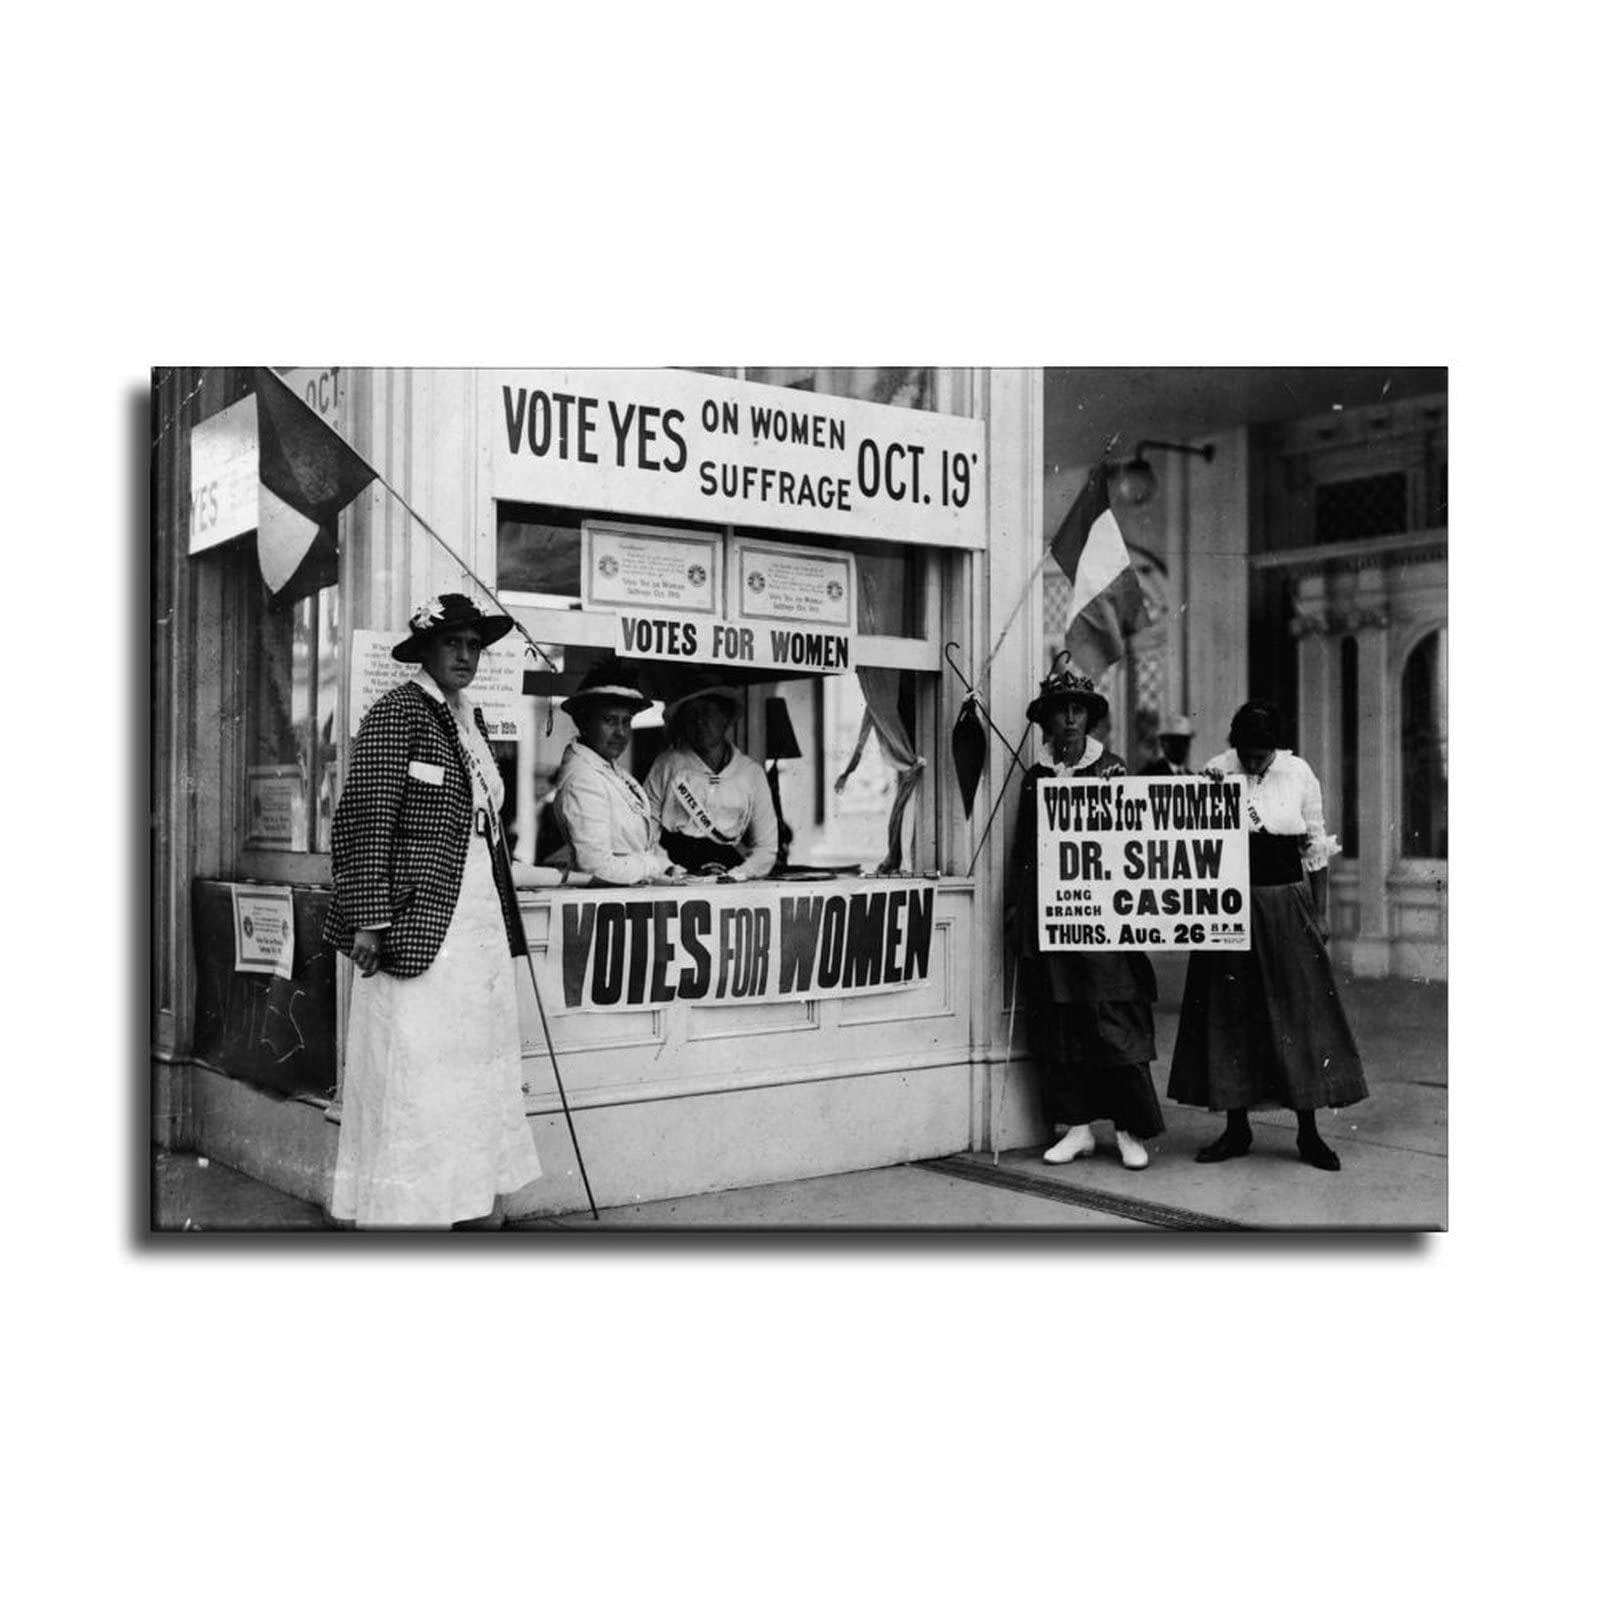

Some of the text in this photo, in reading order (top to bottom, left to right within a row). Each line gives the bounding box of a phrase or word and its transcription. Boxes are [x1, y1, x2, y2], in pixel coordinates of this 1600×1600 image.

[502, 385, 688, 473] VOTE YES
[702, 399, 846, 450] ON WOMEN
[699, 460, 852, 511] SUFFRAGE
[857, 438, 931, 505] OCT.
[621, 617, 849, 668] VOTES FOR WOMEN
[1043, 783, 1241, 832] VOTES for WOMEN
[1059, 839, 1223, 881] DR. SHAW
[1045, 905, 1102, 917] BRANCH
[1056, 889, 1092, 902] LONG
[1112, 888, 1243, 916] CASINO
[562, 887, 934, 1008] VOTES FOR WOMEN
[1045, 924, 1111, 945] THURS.
[1174, 923, 1206, 945] 26
